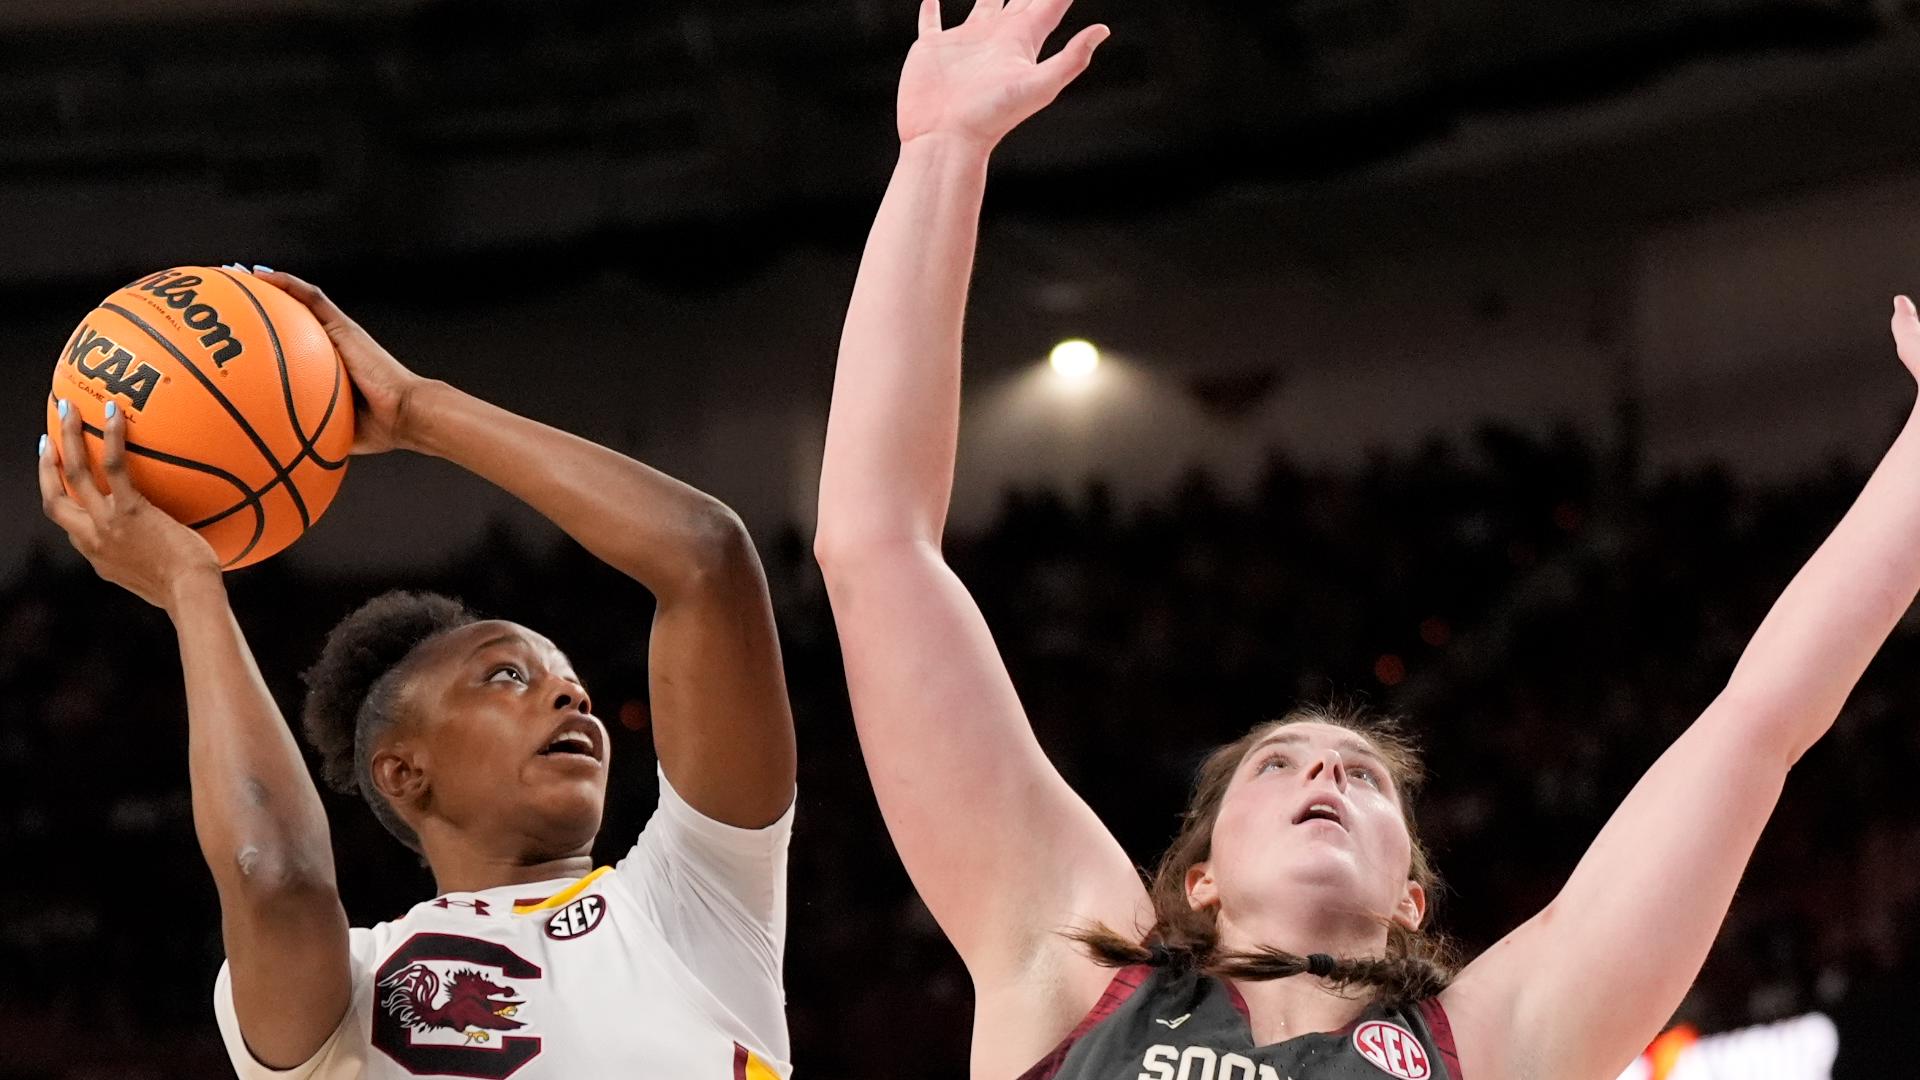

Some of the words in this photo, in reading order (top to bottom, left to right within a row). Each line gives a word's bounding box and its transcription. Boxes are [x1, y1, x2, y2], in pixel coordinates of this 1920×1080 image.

[62, 323, 162, 412] NCAA
[549, 896, 601, 937] SEC
[1360, 1025, 1425, 1078] SEC
